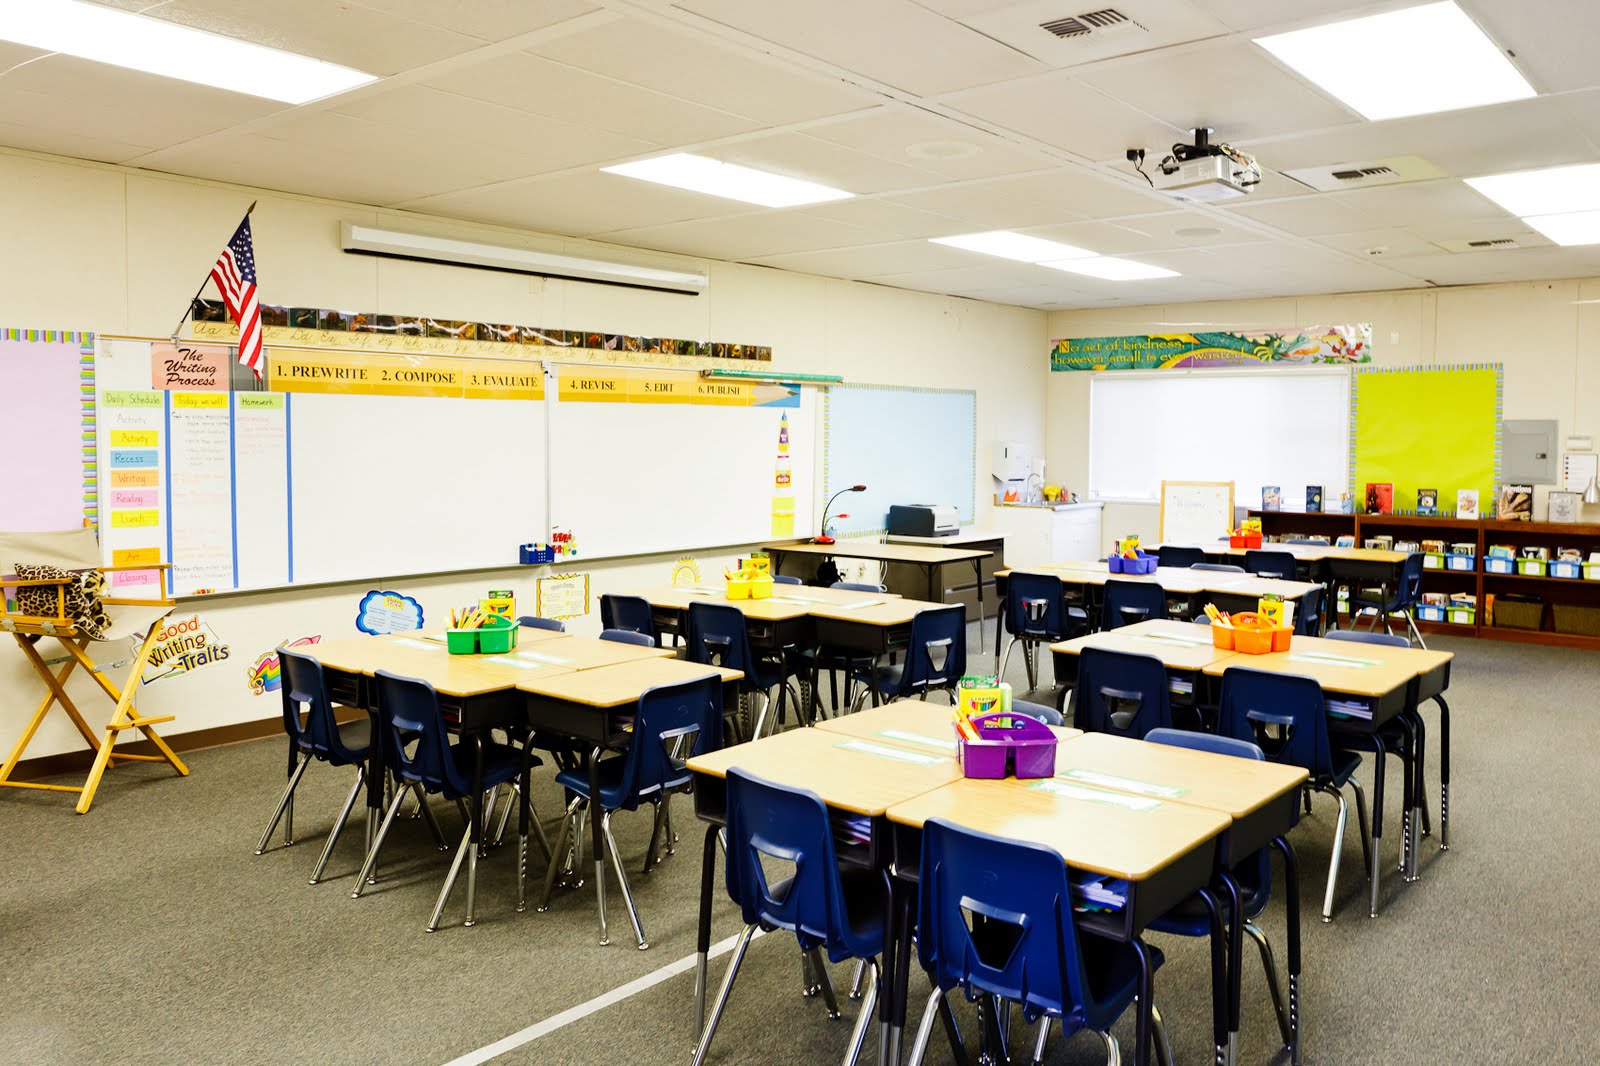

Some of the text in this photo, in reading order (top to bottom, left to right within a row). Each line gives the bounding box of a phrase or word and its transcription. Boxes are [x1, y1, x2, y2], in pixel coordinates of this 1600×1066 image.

[1059, 337, 1184, 353] No act of kindness,
[178, 348, 203, 361] The
[1054, 353, 1105, 365] however
[1109, 350, 1143, 363] small,
[1146, 353, 1156, 361] is
[164, 360, 217, 377] Writing
[277, 365, 368, 380] 1. PREWRITE
[166, 372, 216, 386] Process
[382, 370, 456, 384] 2. COMPOSE
[471, 375, 538, 387] 3. EVALUATE
[570, 380, 616, 391] 4. REVISE
[645, 383, 675, 393] 5. EDIT
[698, 384, 740, 395] 6. PUBLISH
[106, 393, 160, 406] Daily Schedule
[242, 397, 274, 406] Homework
[117, 411, 147, 424] Activity
[121, 433, 149, 444] Activity
[115, 454, 144, 464] Recess
[118, 473, 146, 485] Writing
[116, 493, 143, 505] Reading
[121, 513, 145, 524] Lunch
[127, 552, 141, 561] Art
[119, 572, 148, 583] Closing
[156, 616, 198, 642] Good
[147, 633, 205, 668] Writing
